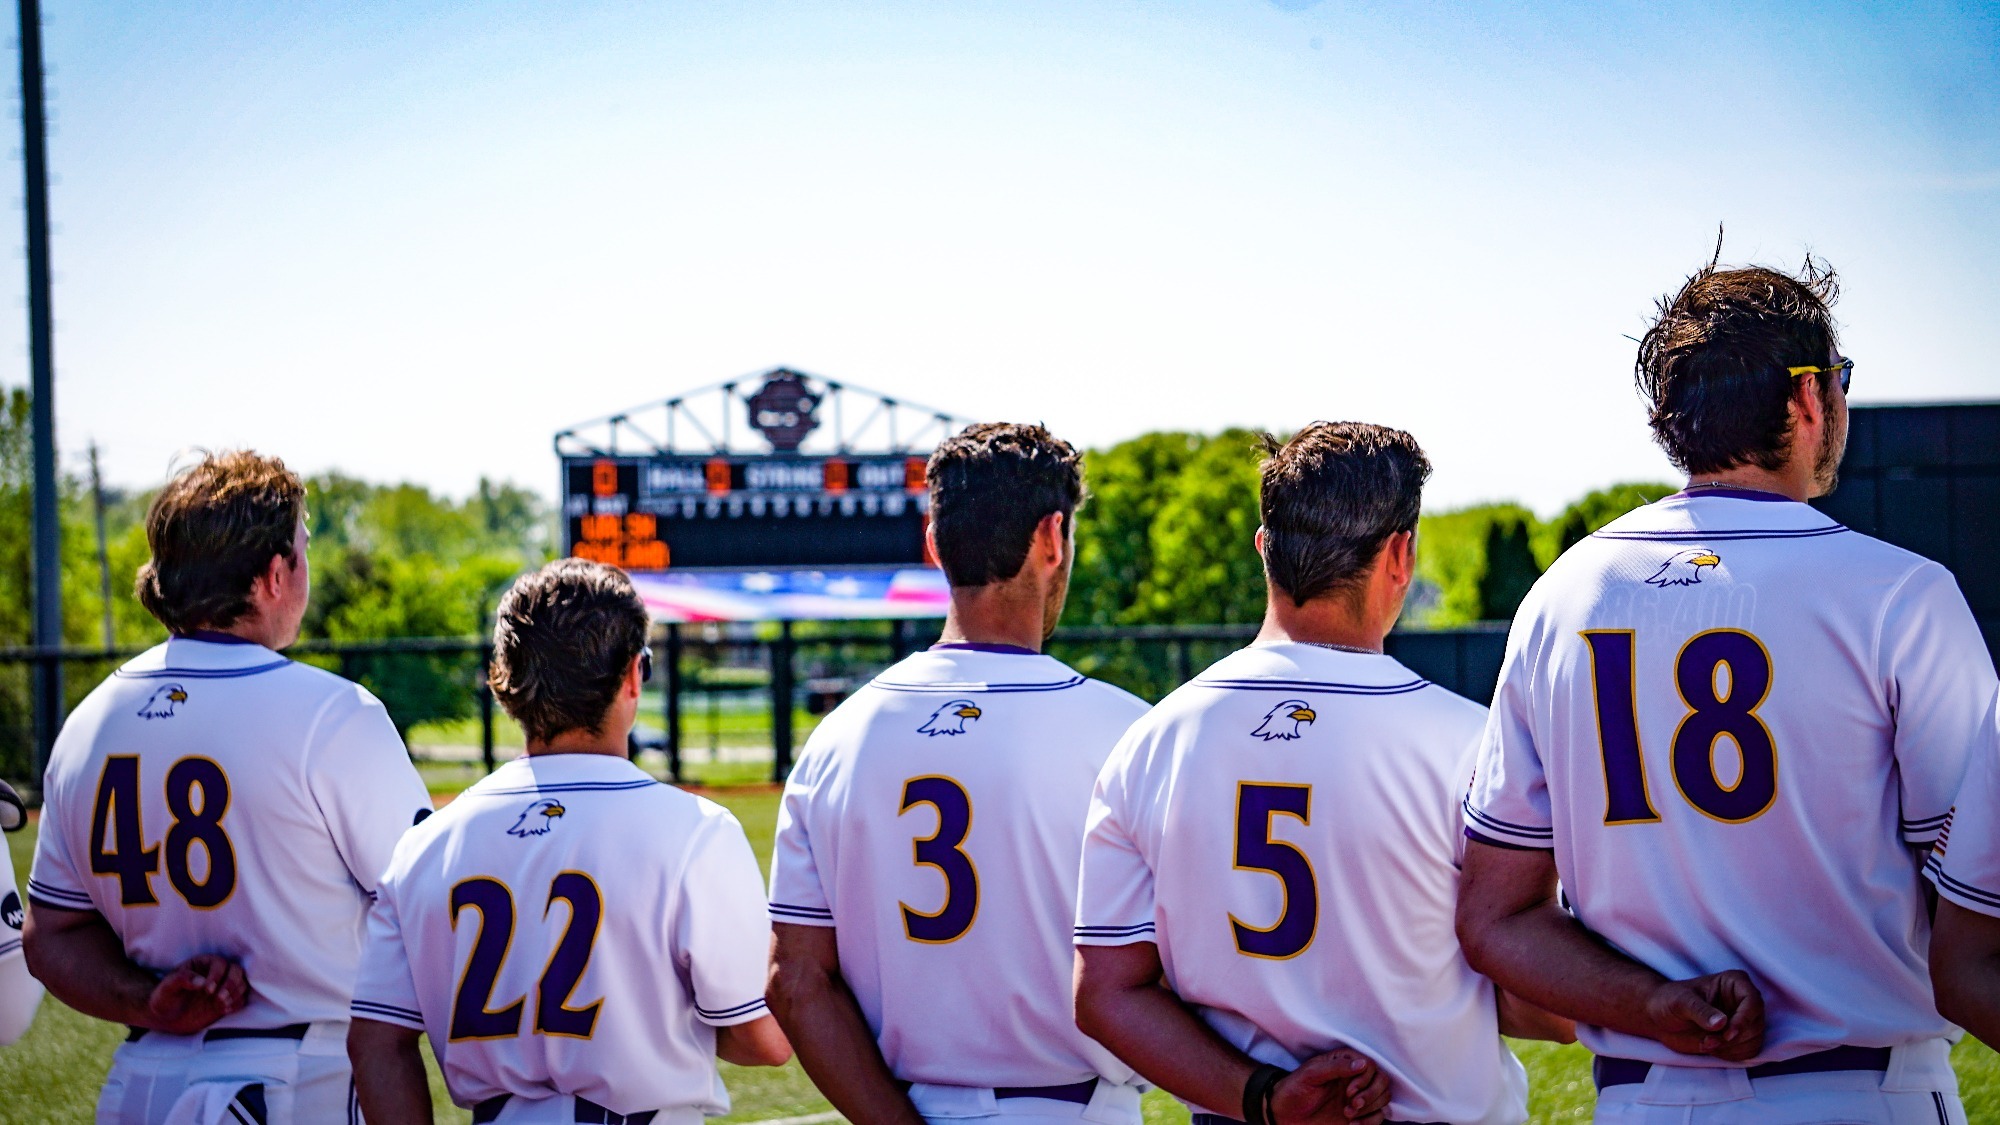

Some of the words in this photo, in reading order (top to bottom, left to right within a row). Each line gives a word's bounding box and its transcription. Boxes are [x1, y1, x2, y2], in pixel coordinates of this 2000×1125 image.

[1580, 627, 1779, 826] 18
[90, 755, 237, 909] 48
[898, 775, 979, 945] 3
[1227, 780, 1320, 960] 5
[448, 870, 606, 1042] 22
